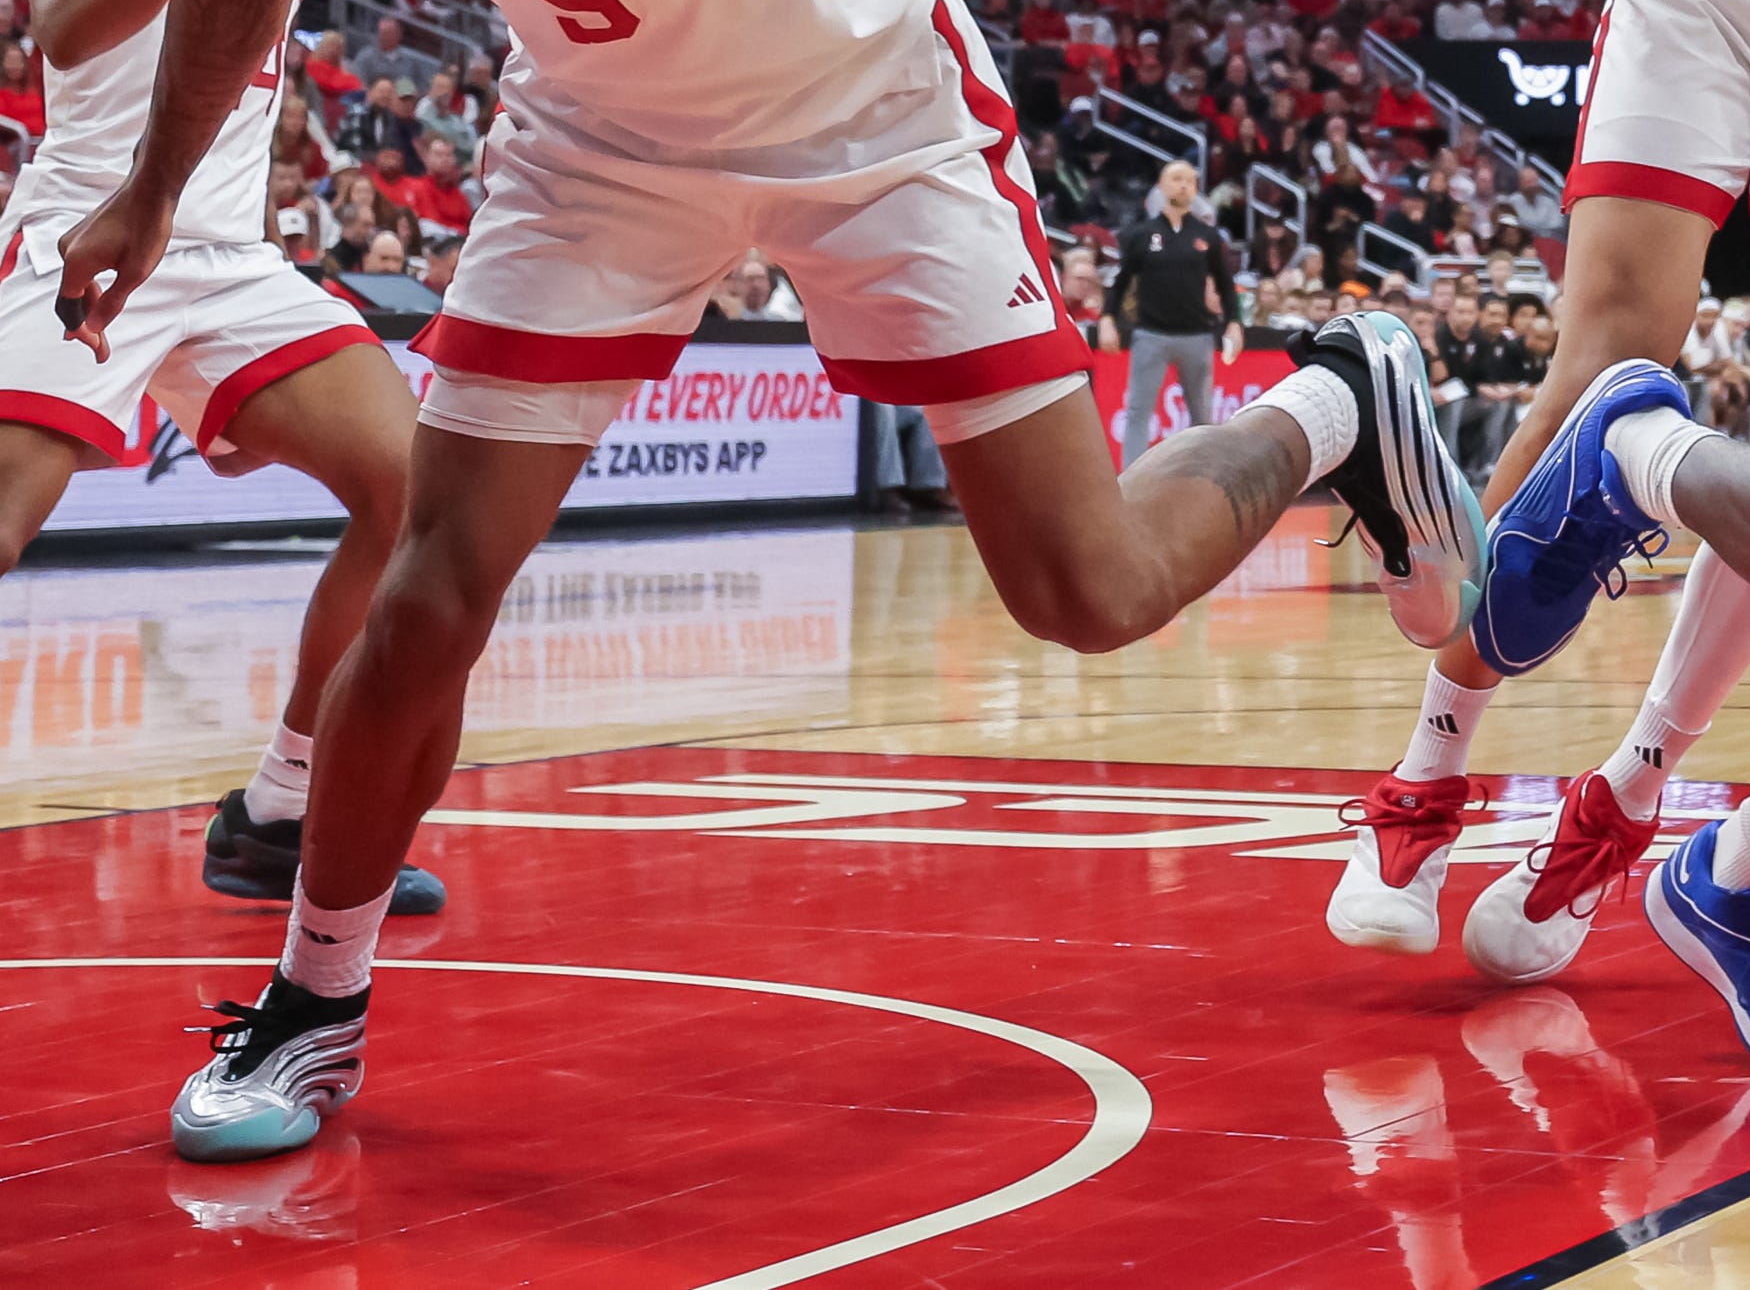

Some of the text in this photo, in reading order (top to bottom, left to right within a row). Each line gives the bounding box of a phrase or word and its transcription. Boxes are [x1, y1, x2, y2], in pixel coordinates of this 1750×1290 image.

[645, 372, 747, 423] EVERY
[748, 371, 843, 421] ORDER
[607, 441, 711, 478] ZAXBYS
[717, 440, 767, 473] APP
